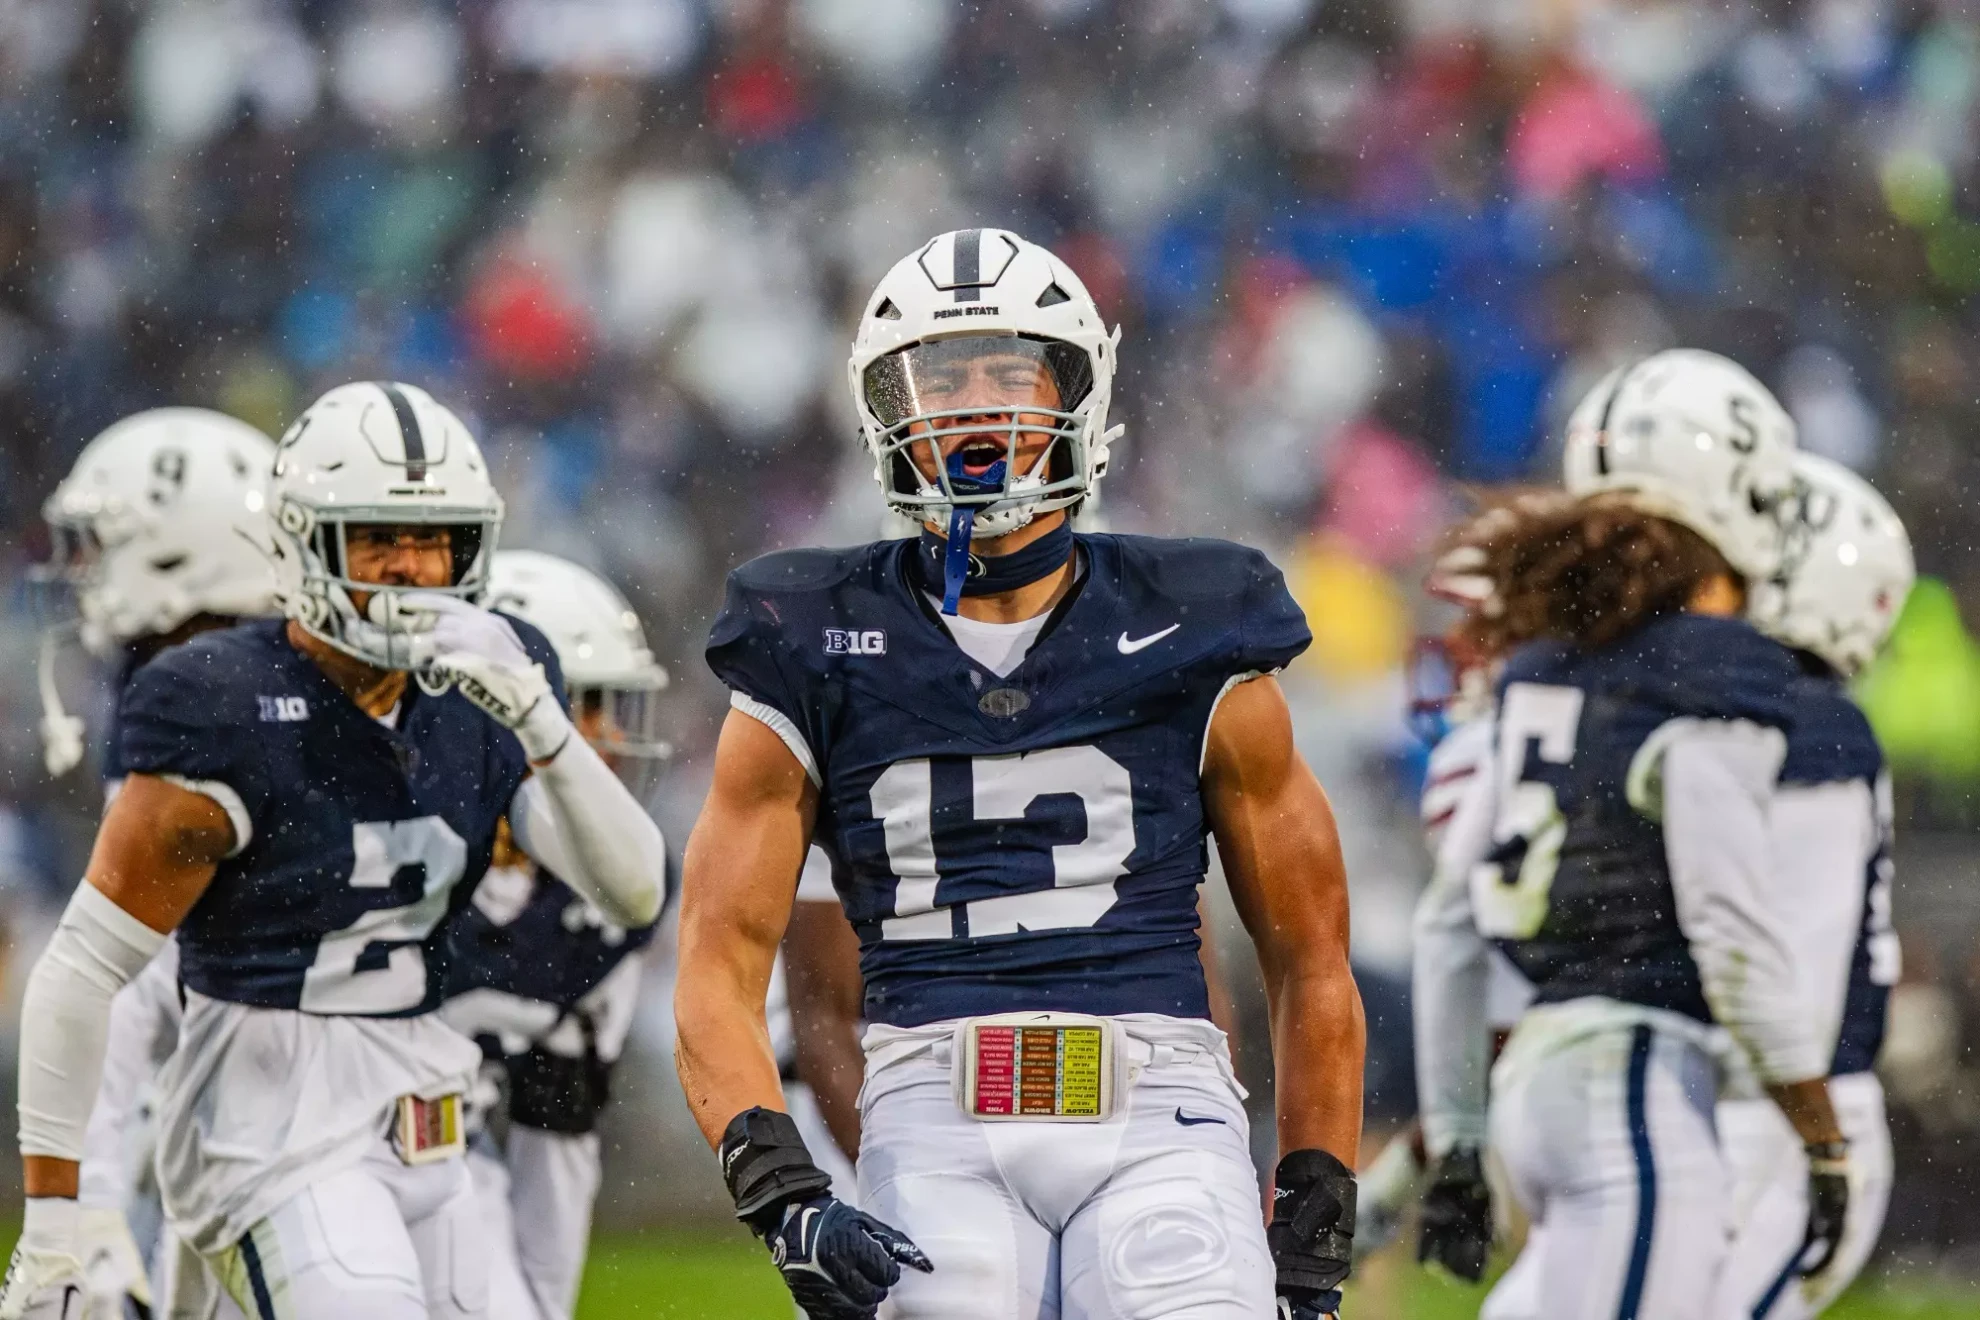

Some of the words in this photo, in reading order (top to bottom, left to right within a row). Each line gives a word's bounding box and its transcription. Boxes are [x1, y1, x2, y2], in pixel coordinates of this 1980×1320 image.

[933, 308, 963, 320] PENN
[965, 306, 999, 316] STATE
[869, 745, 1137, 940] 13
[1471, 681, 1585, 940] 5
[300, 815, 468, 1016] 2
[893, 1242, 918, 1253] PSU
